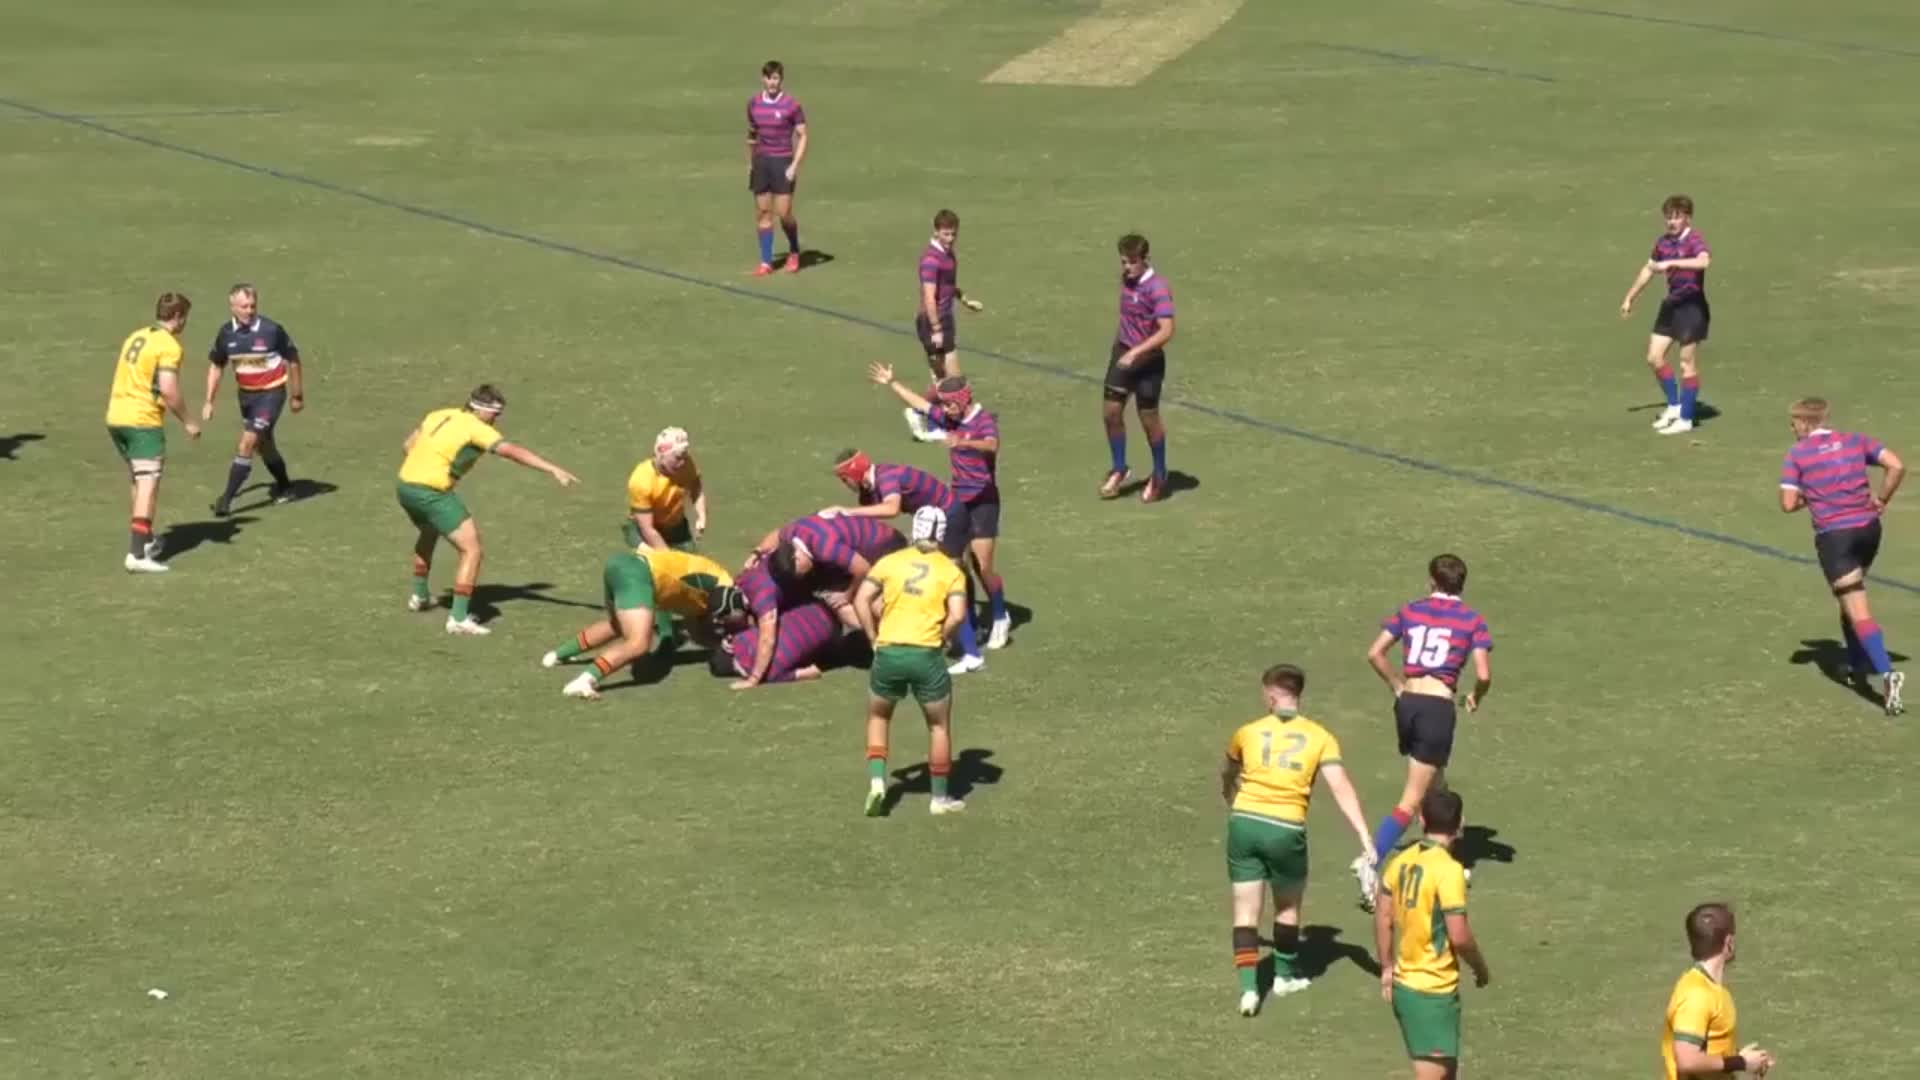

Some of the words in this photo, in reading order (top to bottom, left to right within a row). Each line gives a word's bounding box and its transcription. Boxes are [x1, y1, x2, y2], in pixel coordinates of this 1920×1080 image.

[126, 336, 147, 365] 8
[903, 562, 929, 596] 2
[1407, 625, 1452, 668] 15
[1260, 730, 1307, 771] 12
[1398, 863, 1424, 909] 10
